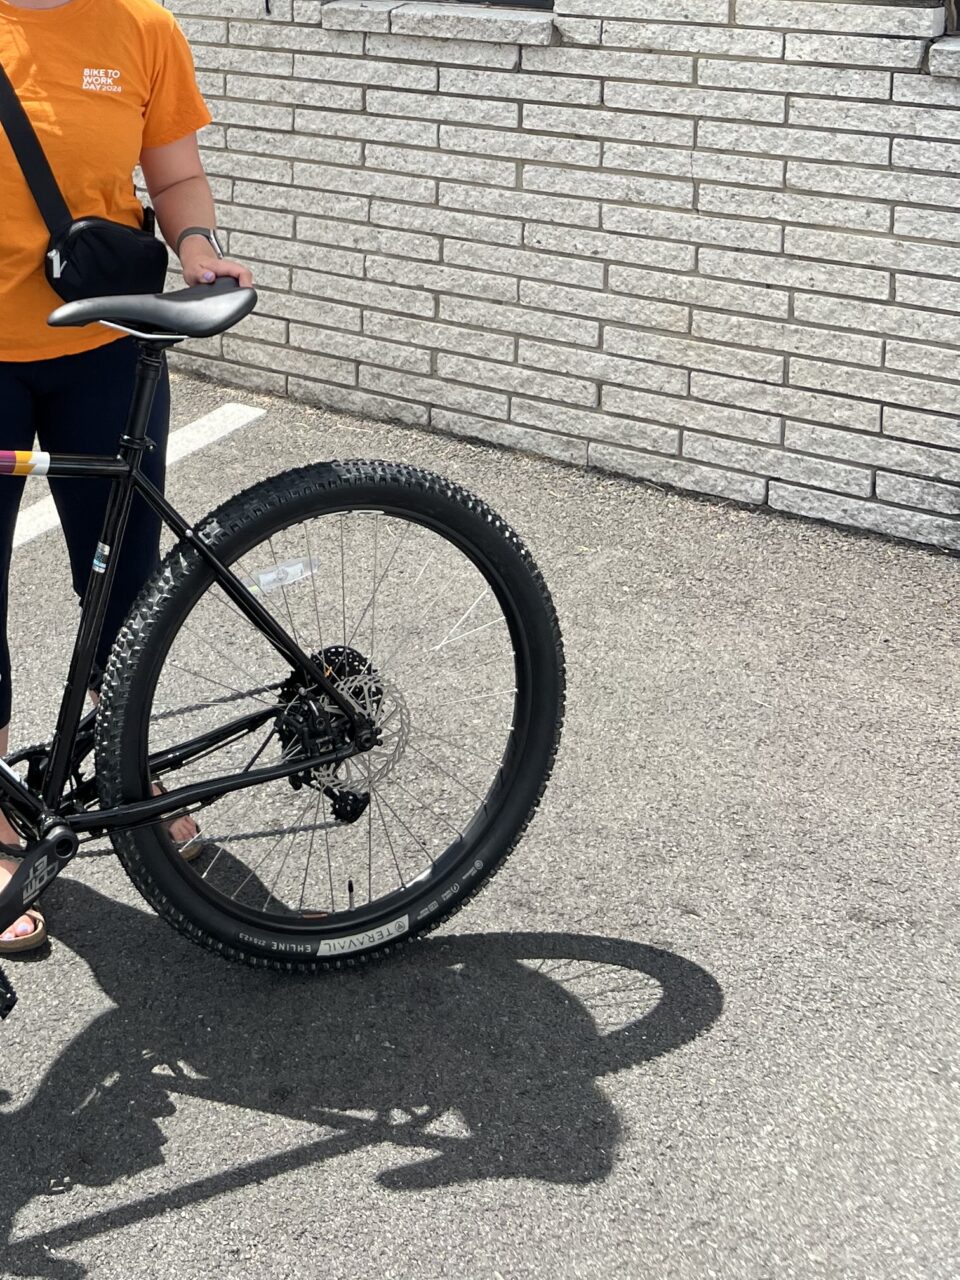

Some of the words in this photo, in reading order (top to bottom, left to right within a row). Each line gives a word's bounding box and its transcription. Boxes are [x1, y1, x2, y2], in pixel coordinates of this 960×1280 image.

[83, 68, 106, 77] BIKE
[107, 69, 121, 79] TO
[82, 76, 114, 85] WORK
[82, 82, 101, 91] DAY
[323, 927, 394, 953] TERAVAIL
[271, 941, 312, 953] EHLINE
